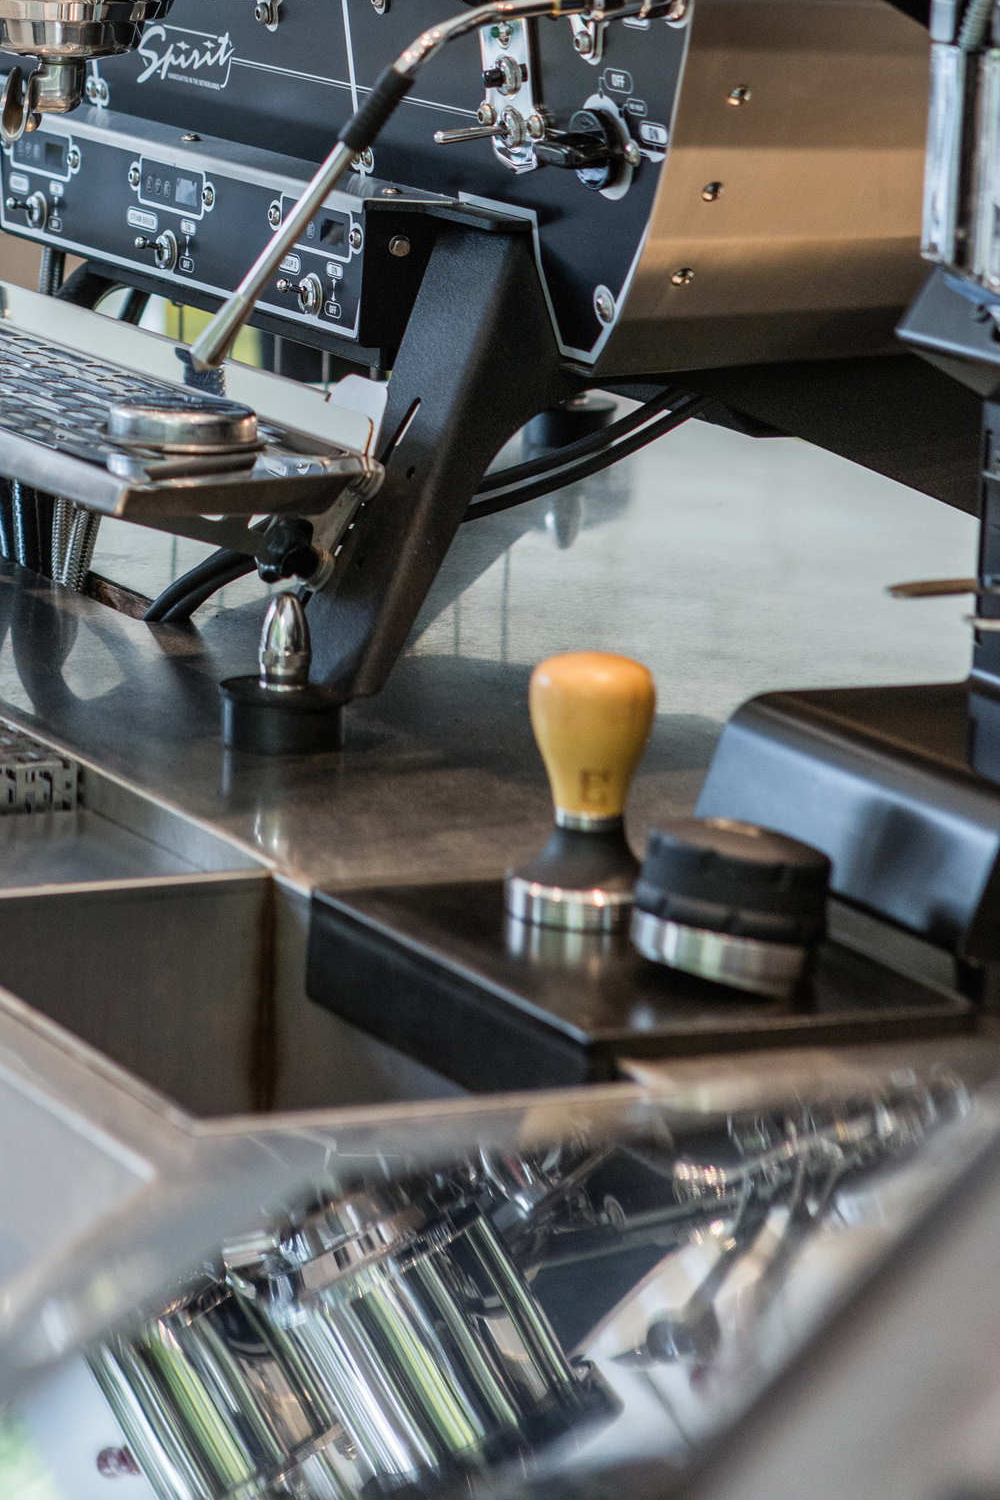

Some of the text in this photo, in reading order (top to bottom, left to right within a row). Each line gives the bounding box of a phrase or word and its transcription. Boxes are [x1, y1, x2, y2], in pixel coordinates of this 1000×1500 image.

[137, 25, 235, 83] Spirit
[611, 73, 625, 88] OFF
[648, 127, 660, 140] ON
[332, 265, 338, 274] ON
[329, 305, 337, 315] OFF
